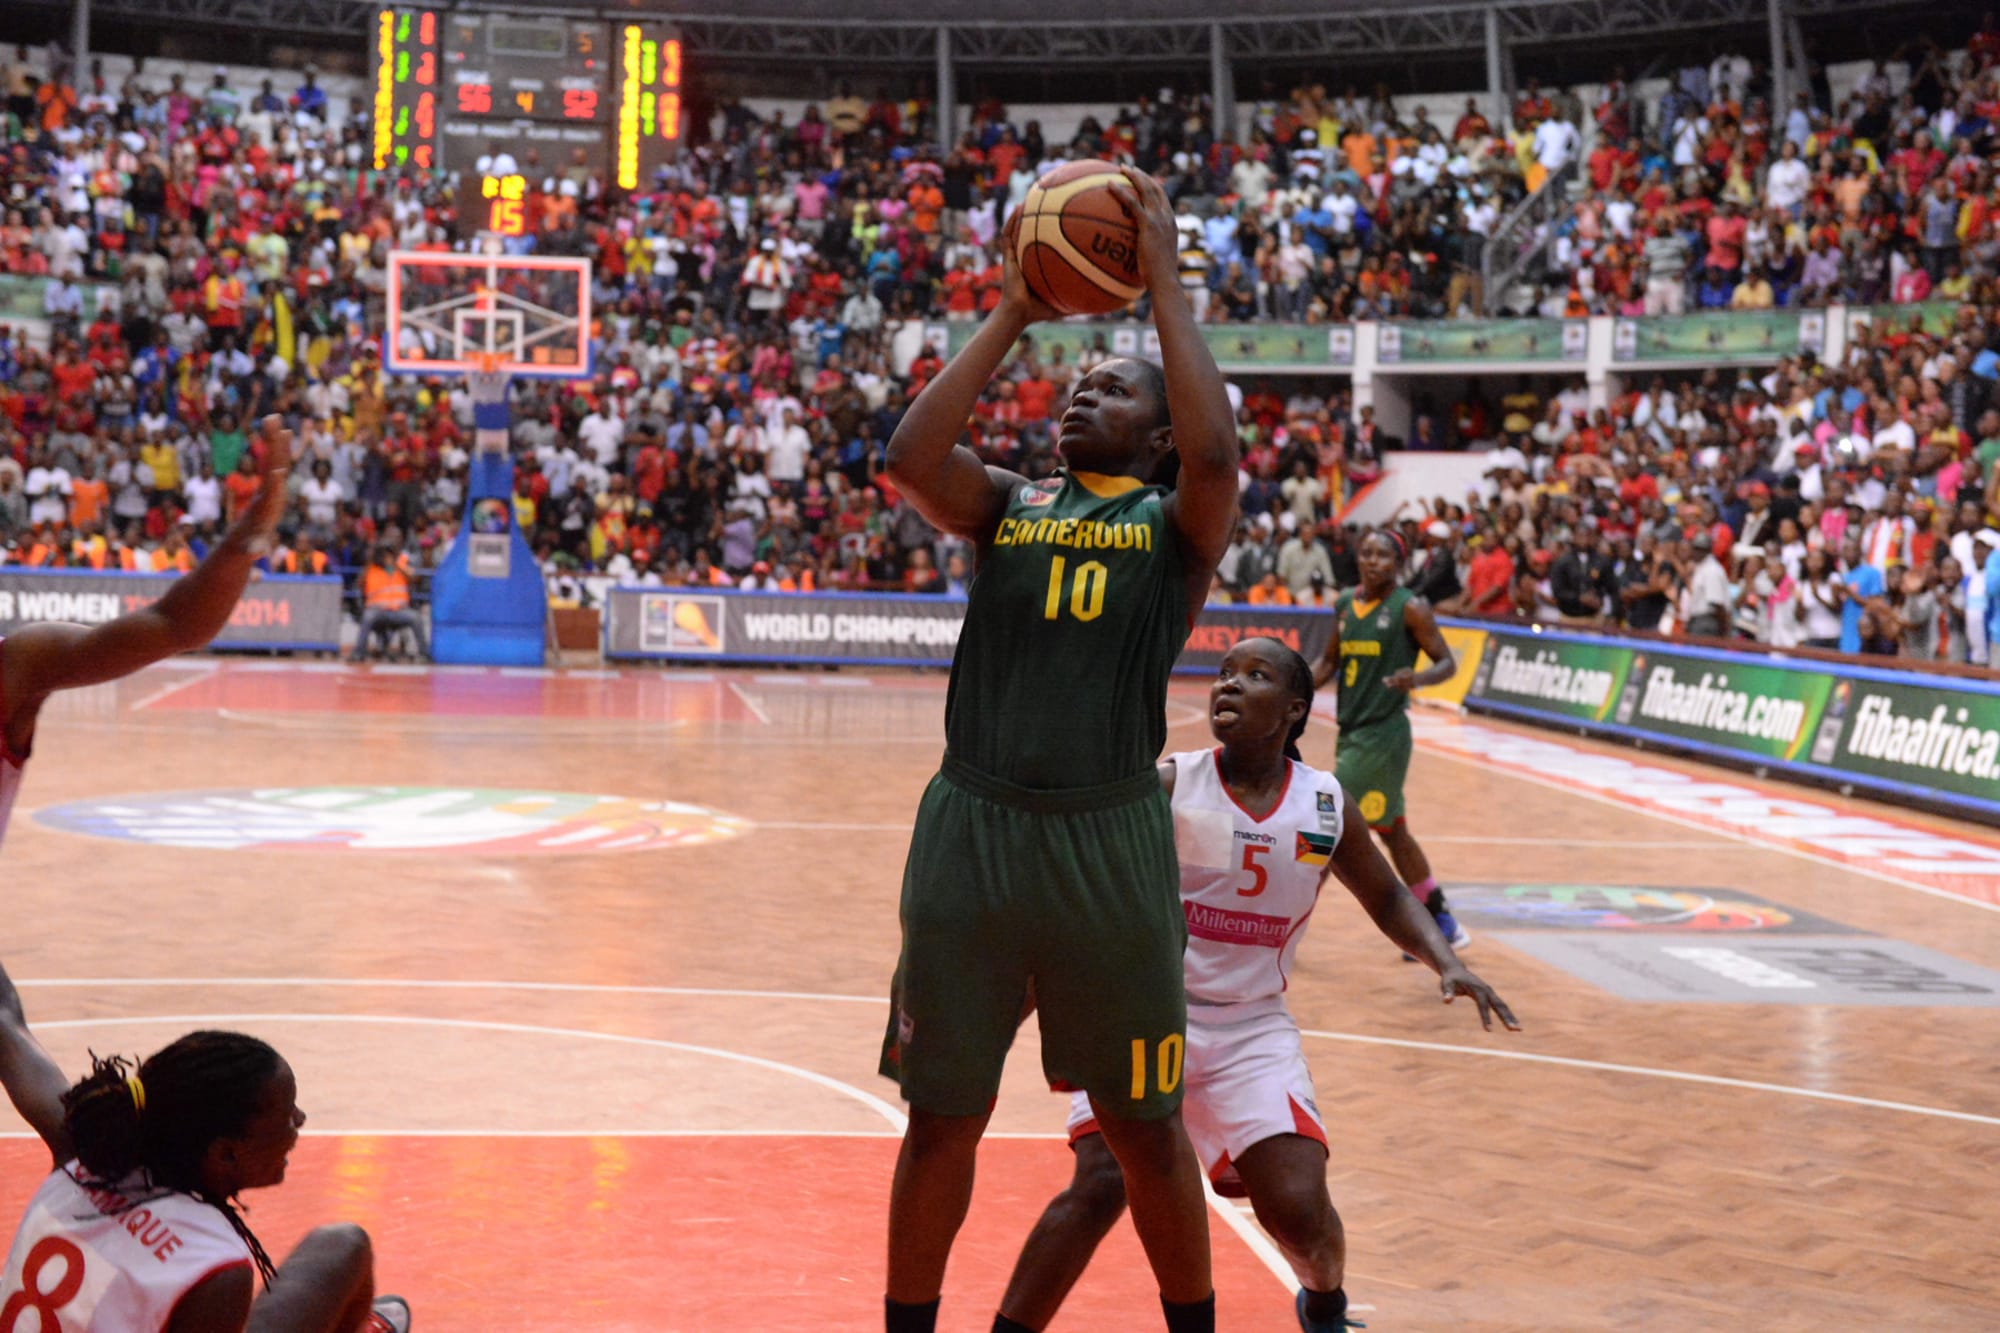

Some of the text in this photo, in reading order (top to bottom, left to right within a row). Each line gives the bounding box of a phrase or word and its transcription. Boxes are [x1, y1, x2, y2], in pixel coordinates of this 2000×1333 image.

[489, 199, 525, 237] 15
[18, 591, 119, 622] WOMEN
[1044, 555, 1108, 622] 10
[745, 613, 831, 641] WORLD
[1641, 664, 1804, 742] fibaafrica.com
[1233, 830, 1277, 845] macron
[1236, 844, 1270, 897] 5
[1131, 1033, 1184, 1099] 10
[0, 1235, 85, 1333] 8
